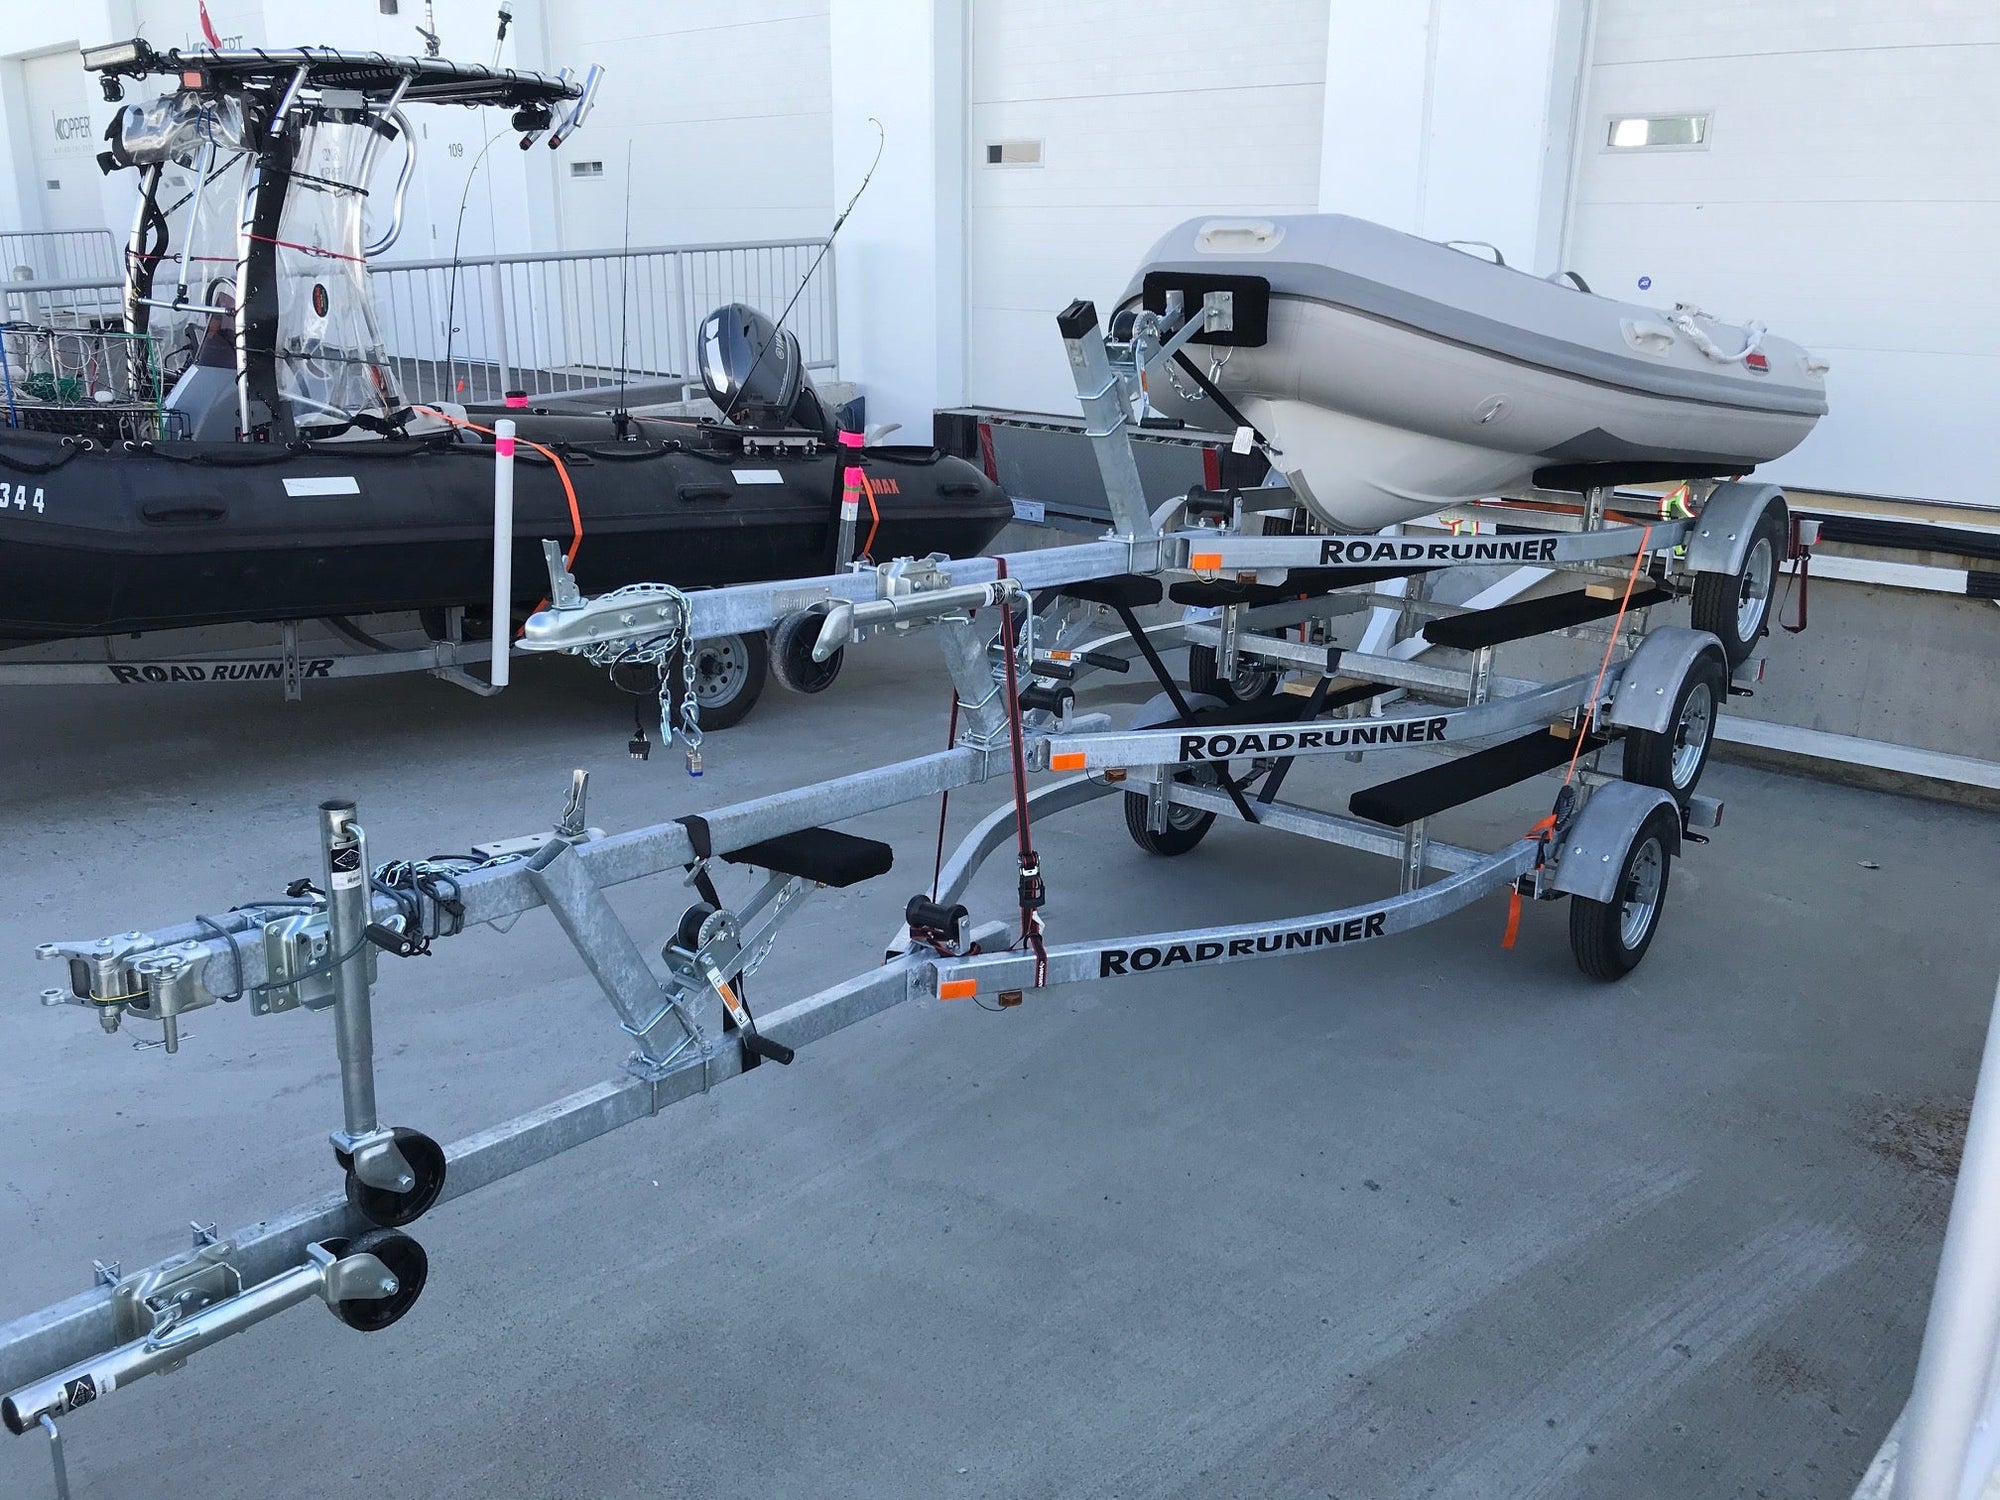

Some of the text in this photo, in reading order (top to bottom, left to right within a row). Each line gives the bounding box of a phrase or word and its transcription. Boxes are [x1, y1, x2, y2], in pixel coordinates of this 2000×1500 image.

[52, 109, 93, 140] KOPPER
[448, 143, 463, 157] 109
[0, 482, 45, 513] 344
[1320, 538, 1557, 565] ROADRUNNER
[108, 659, 334, 684] ROAD RUNNR
[1179, 717, 1448, 762] ROADRUNNER
[1099, 912, 1387, 978] ROADRUNNER
